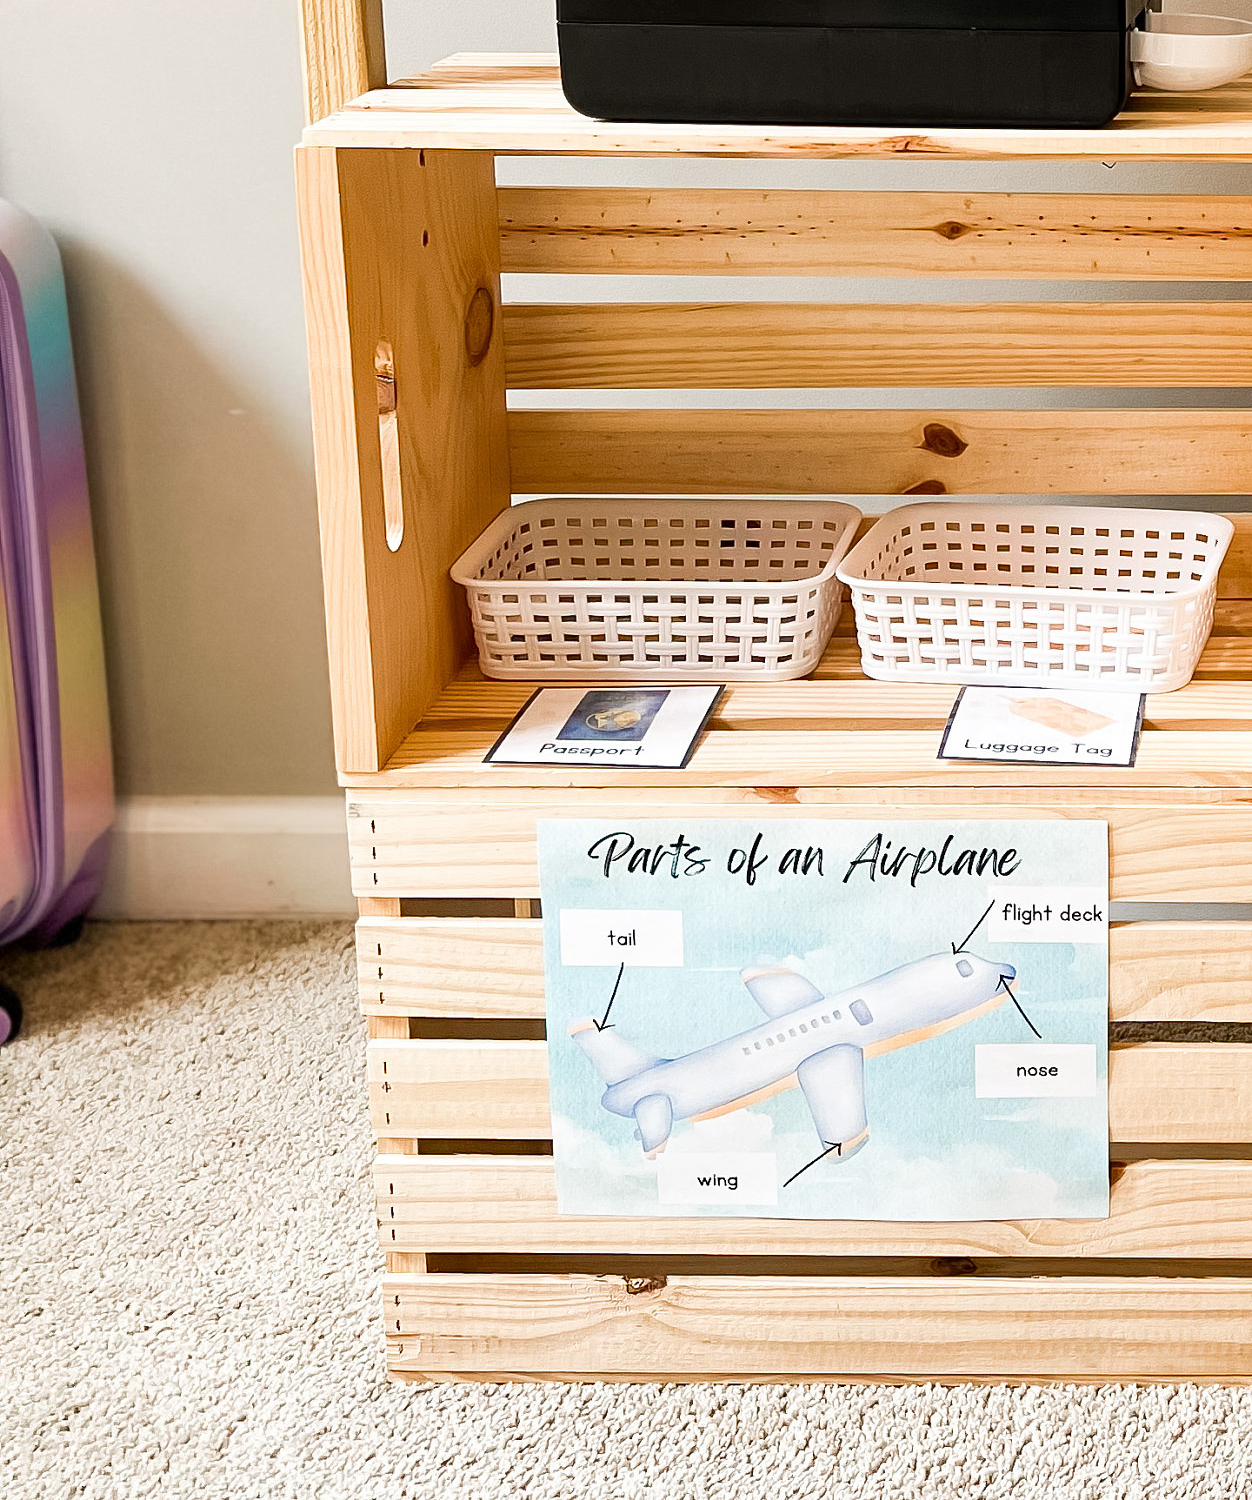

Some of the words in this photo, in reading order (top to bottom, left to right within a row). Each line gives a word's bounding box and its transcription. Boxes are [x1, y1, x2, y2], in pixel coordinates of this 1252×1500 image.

[537, 741, 645, 757] Passport
[964, 738, 1060, 755] Luggage
[1071, 743, 1113, 758] Tag
[588, 832, 711, 879] Parts
[727, 832, 769, 886] of
[779, 845, 824, 877] an
[843, 832, 1022, 888] Airplane
[1001, 903, 1053, 926] flight
[1059, 903, 1103, 922] deck
[607, 929, 637, 946] tail
[1015, 1064, 1058, 1078] nose
[697, 1172, 738, 1191] wing
